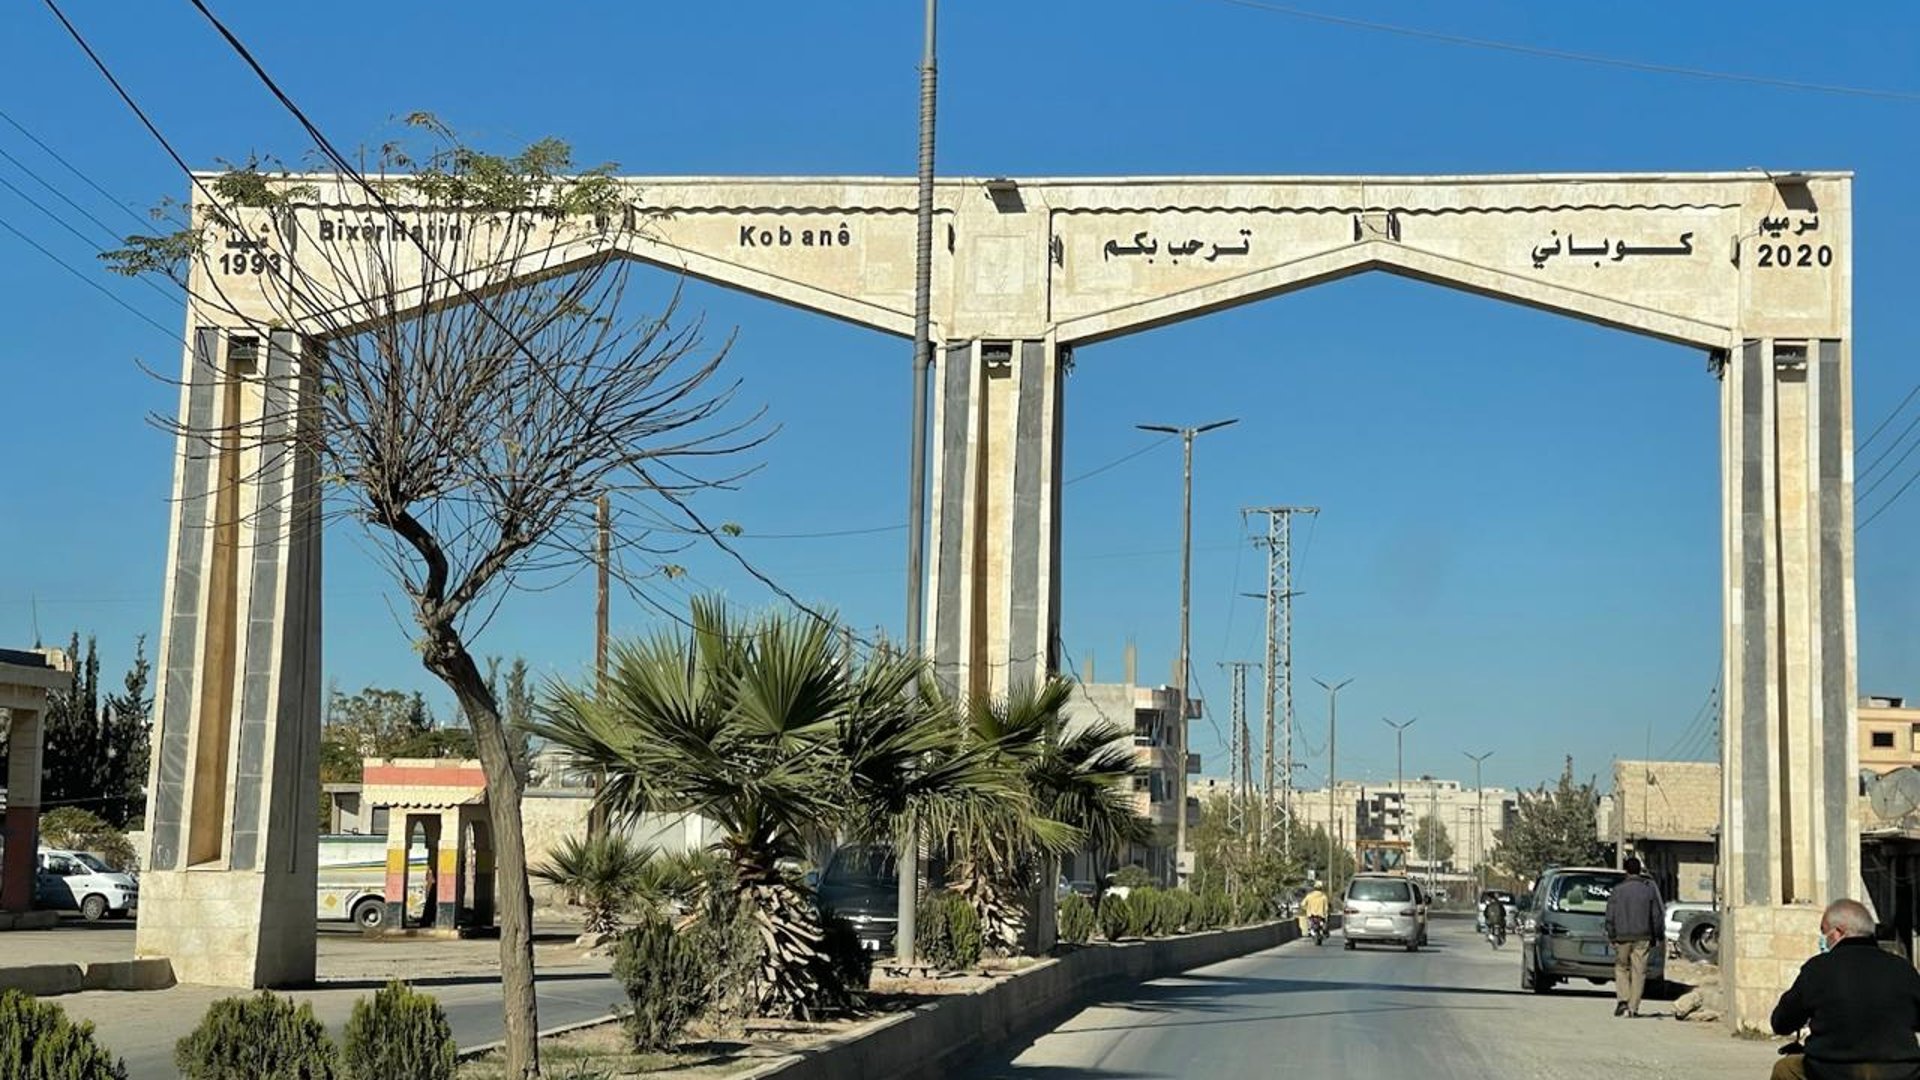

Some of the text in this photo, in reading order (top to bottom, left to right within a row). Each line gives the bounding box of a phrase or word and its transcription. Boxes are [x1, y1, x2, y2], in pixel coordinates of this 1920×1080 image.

[319, 217, 384, 241] Bixêr
[740, 221, 850, 247] Kobanê
[1759, 209, 1819, 238] ترميم
[1104, 229, 1252, 265] ترحب بكم
[1531, 229, 1693, 268] كوباني
[1758, 244, 1832, 267] 2020
[219, 253, 281, 275] 1993
